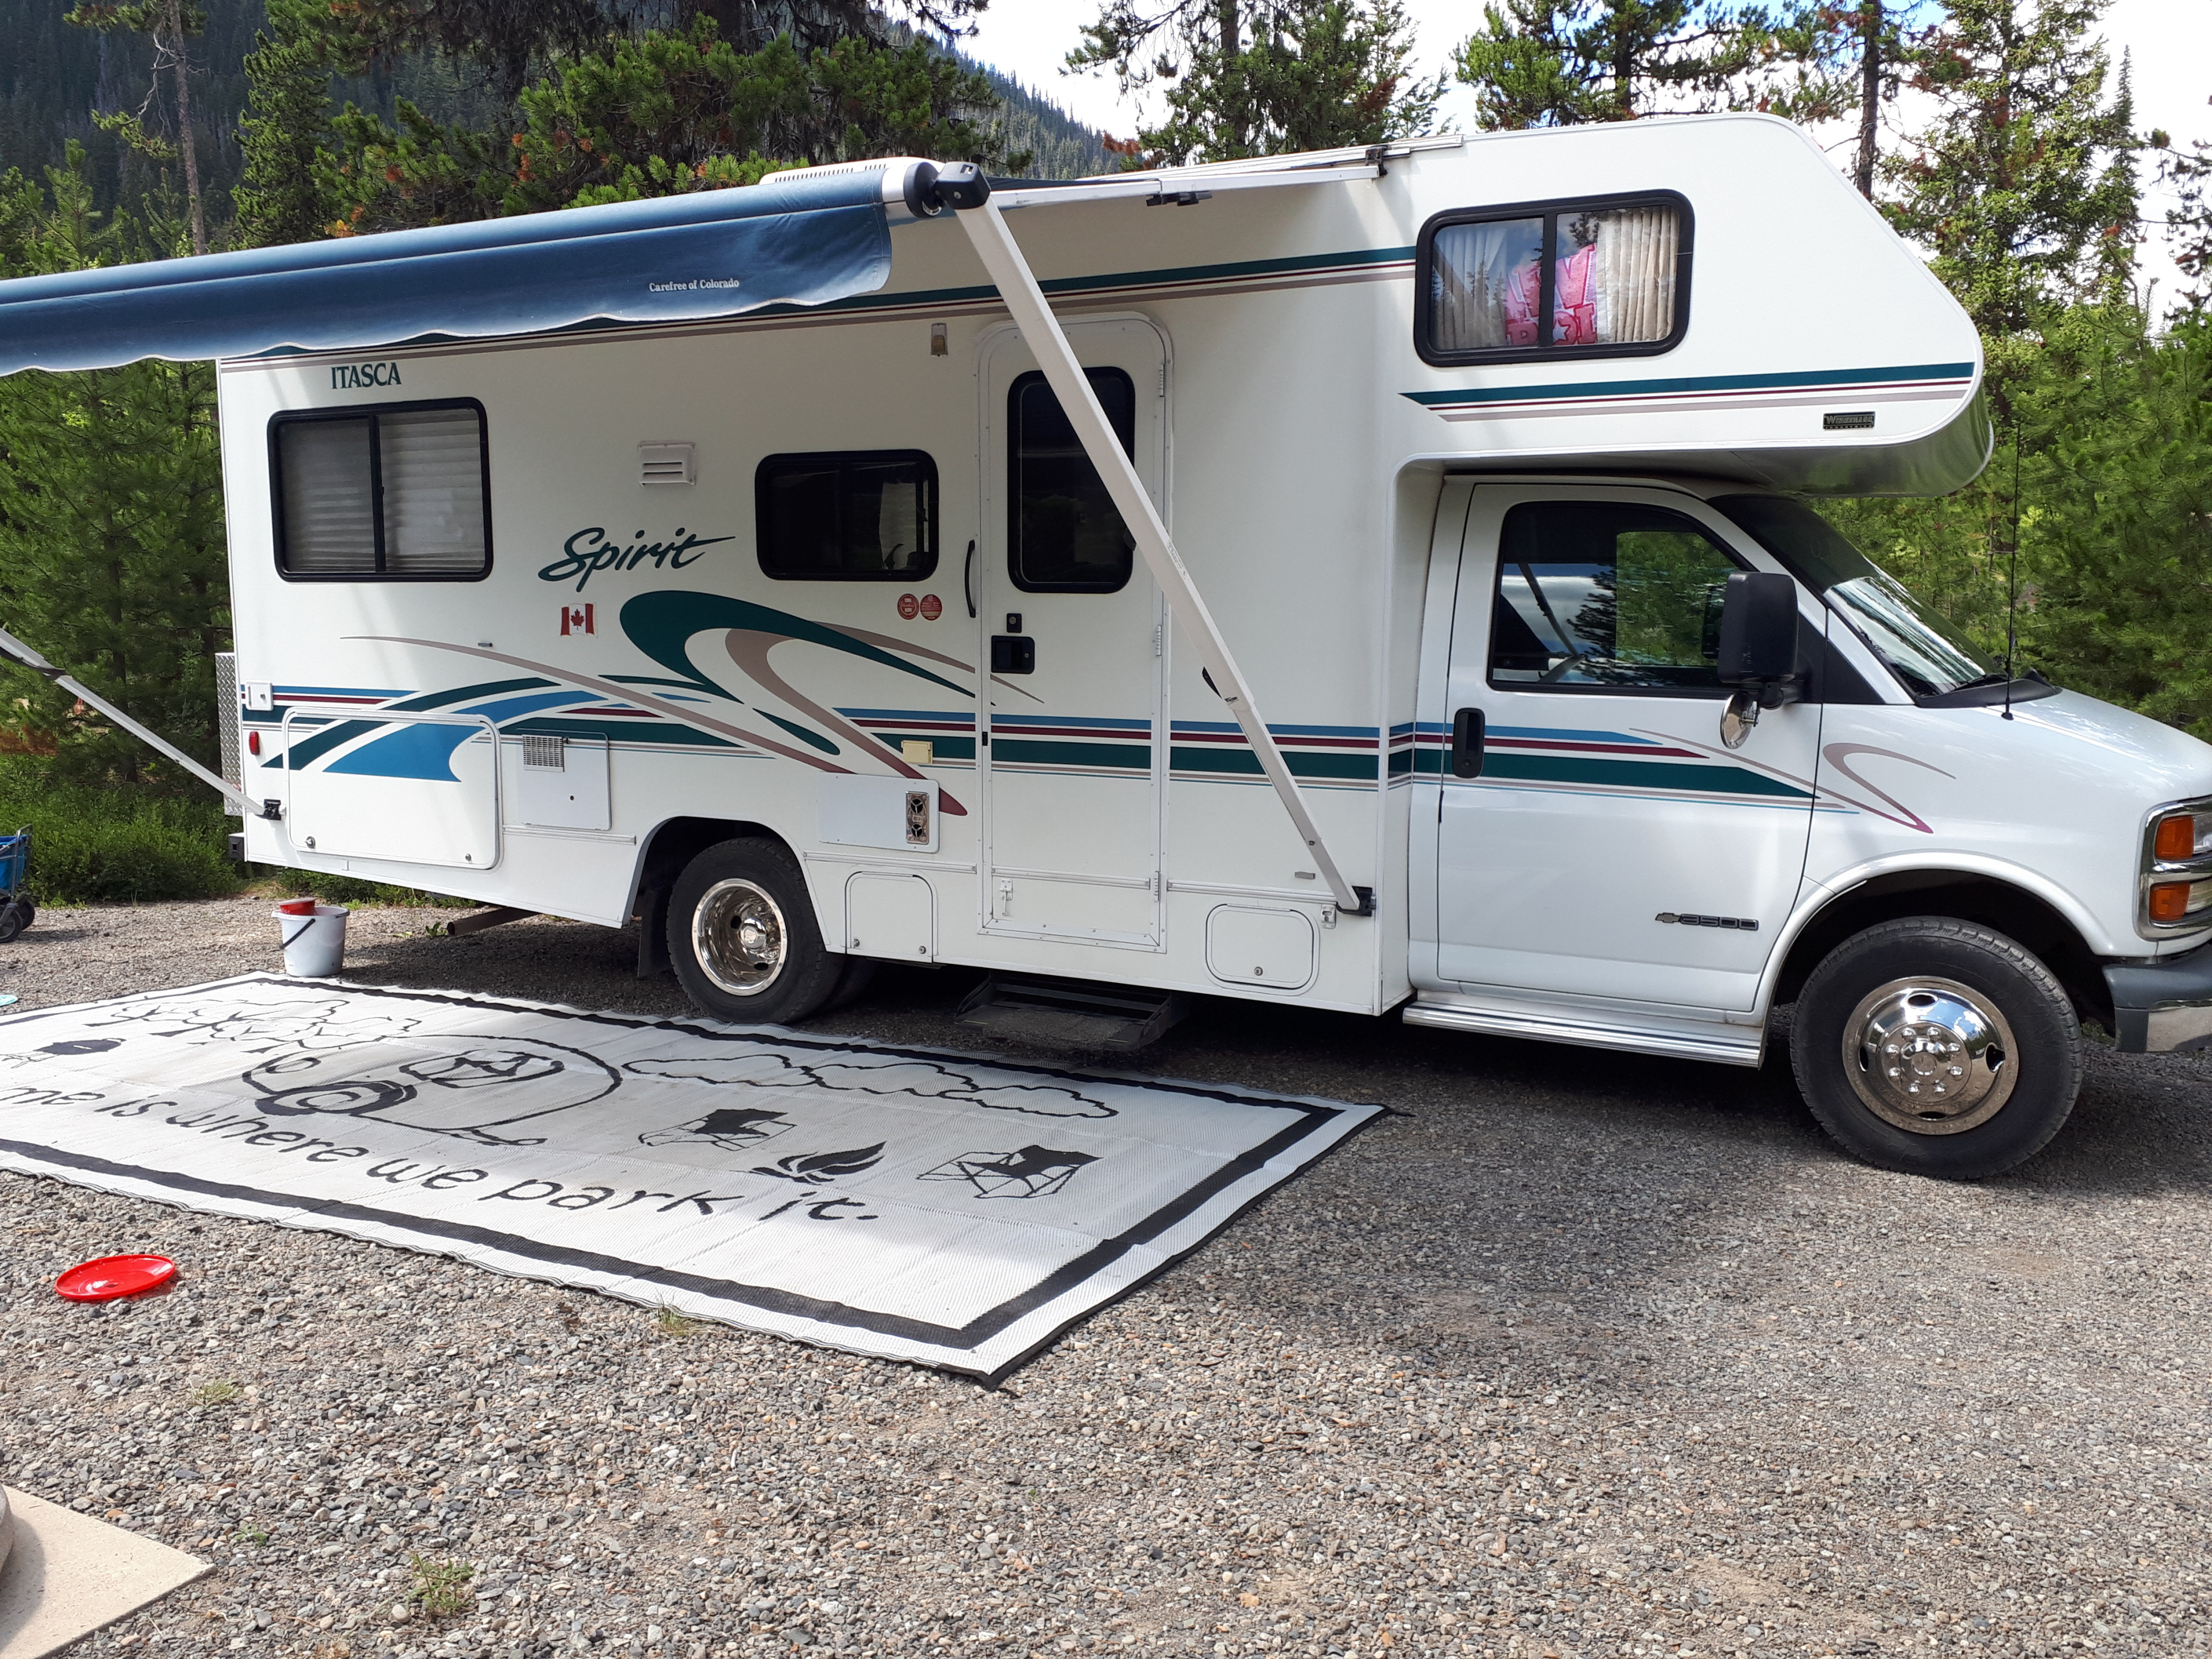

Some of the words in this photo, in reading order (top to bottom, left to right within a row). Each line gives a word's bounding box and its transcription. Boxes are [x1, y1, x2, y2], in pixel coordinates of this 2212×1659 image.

[649, 280, 687, 293] Carefree
[688, 279, 698, 290] of
[700, 278, 740, 289] Colorado
[331, 362, 403, 389] ITASCA
[538, 527, 736, 593] Spirit
[1679, 913, 1759, 931] 3500
[94, 1094, 178, 1117] is
[166, 1114, 369, 1162] where
[367, 1158, 489, 1189] we
[477, 1178, 745, 1215] park
[757, 1191, 879, 1221] it.
